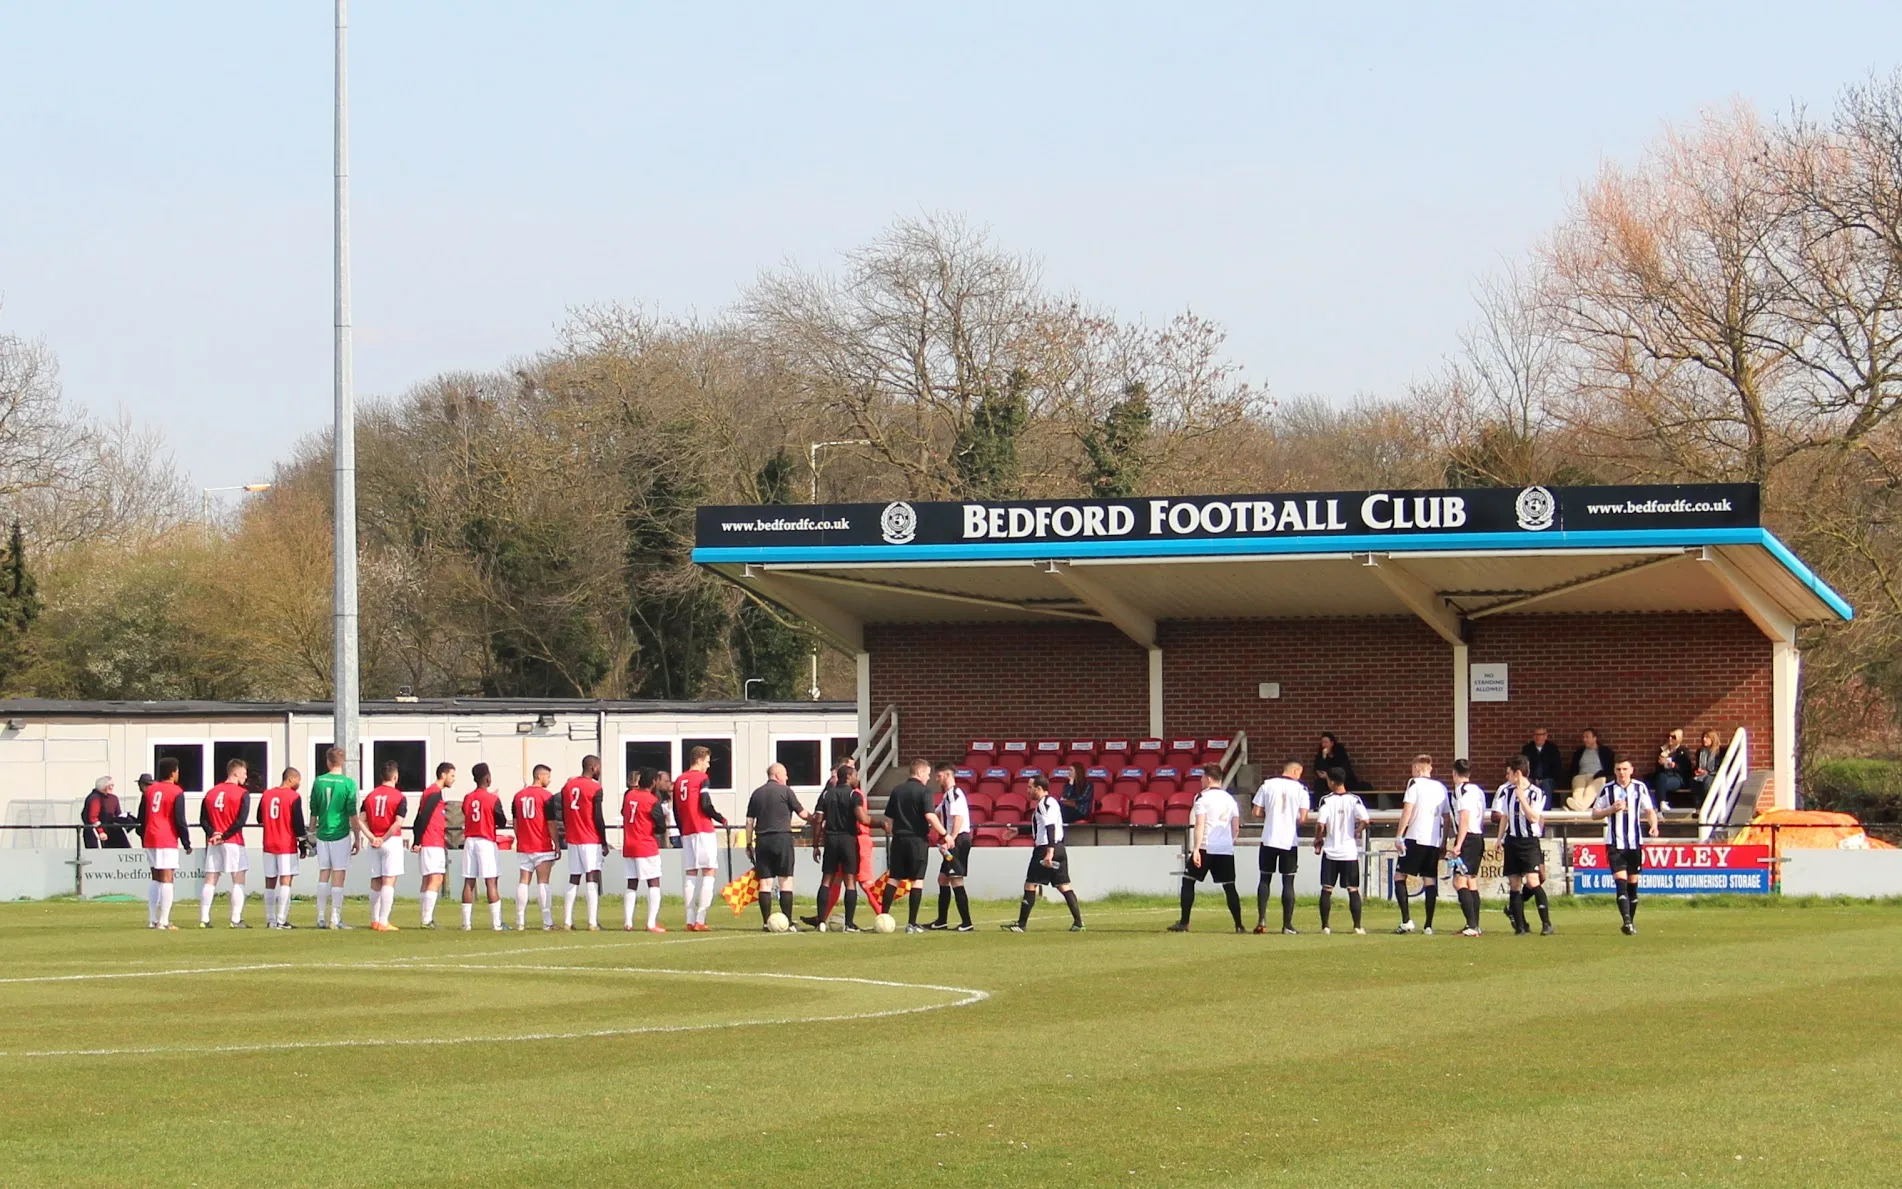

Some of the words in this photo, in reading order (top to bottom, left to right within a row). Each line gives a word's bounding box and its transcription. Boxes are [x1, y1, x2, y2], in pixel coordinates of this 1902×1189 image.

[962, 504, 1135, 539] BEDFORD
[1148, 499, 1348, 535] FOOTBALL
[1360, 492, 1467, 530] CLUB
[1586, 500, 1732, 515] www.bedfordfc.co.uk
[721, 517, 850, 532] www.bedfordfc.co.uk
[151, 790, 163, 814] 9
[214, 789, 226, 812] 4
[570, 787, 581, 811] 2
[679, 779, 689, 802] 5
[269, 796, 281, 820] 6
[374, 794, 389, 817] 11
[471, 799, 482, 822] 3
[520, 796, 537, 819] 10
[629, 800, 639, 824] 7
[118, 853, 144, 863] VISIT
[1578, 847, 1597, 867] &
[85, 868, 206, 880] www.bedforco.uk
[1581, 874, 1592, 888] UK
[1593, 874, 1600, 888] &
[1637, 874, 1674, 889] REMOVALS
[1675, 873, 1729, 889] CONTAINERISED
[1729, 873, 1761, 889] STORAGE
